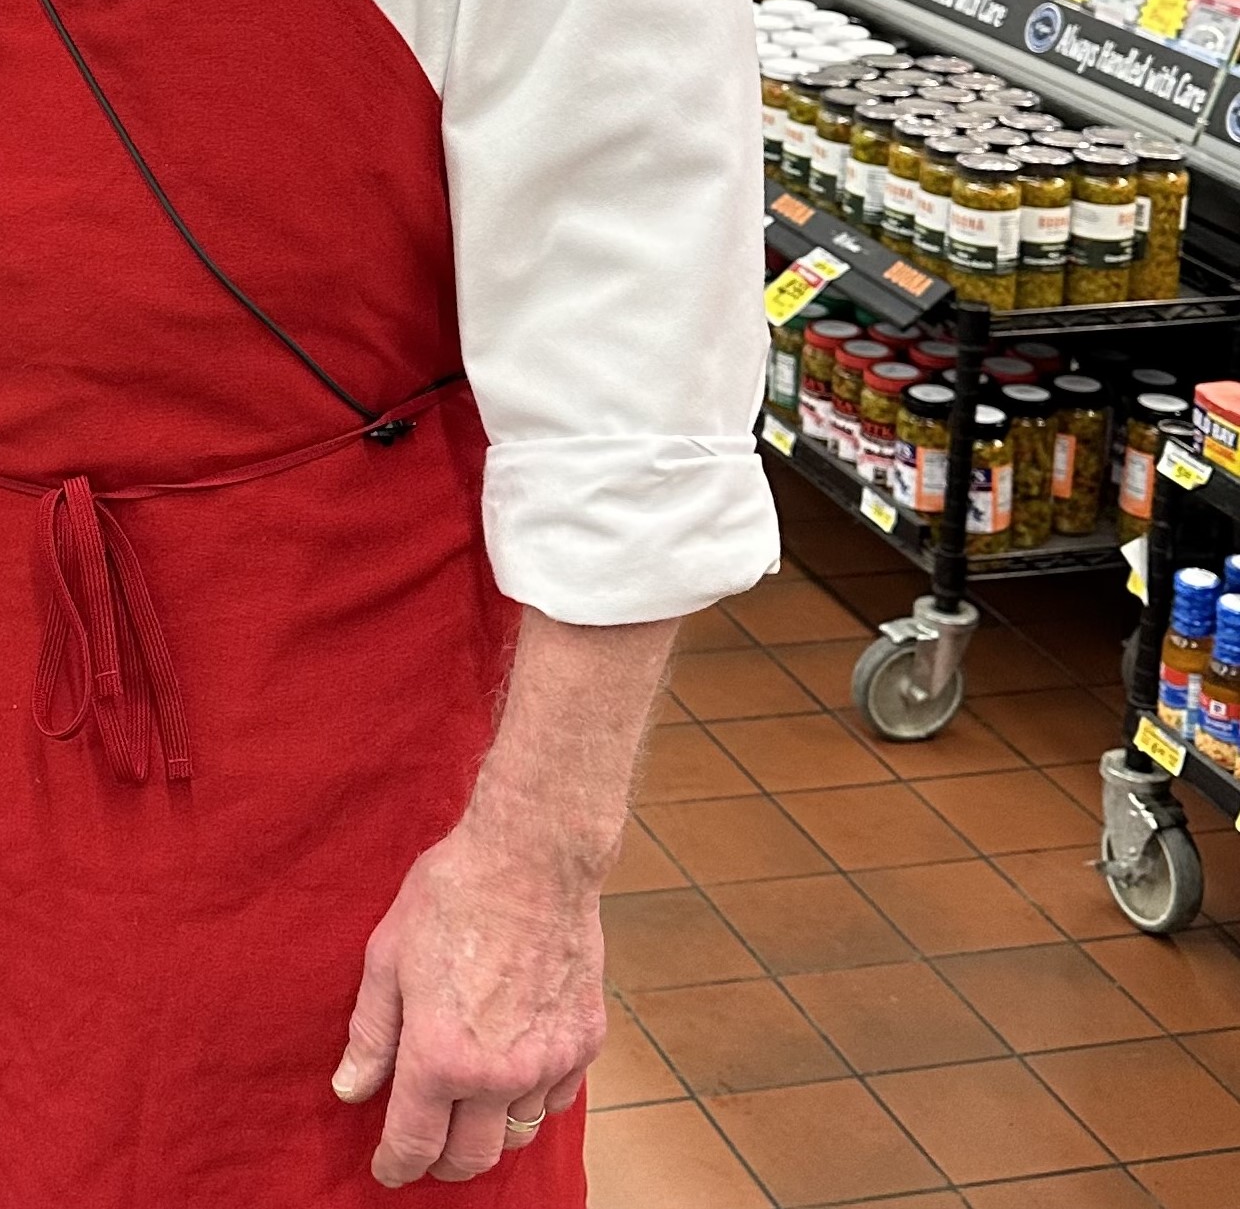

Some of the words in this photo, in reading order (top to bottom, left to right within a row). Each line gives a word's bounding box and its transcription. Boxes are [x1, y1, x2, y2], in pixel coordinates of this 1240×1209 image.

[1055, 23, 1100, 74] Always
[1095, 40, 1154, 88] Handled
[1144, 64, 1179, 101] with
[1173, 72, 1208, 113] Care
